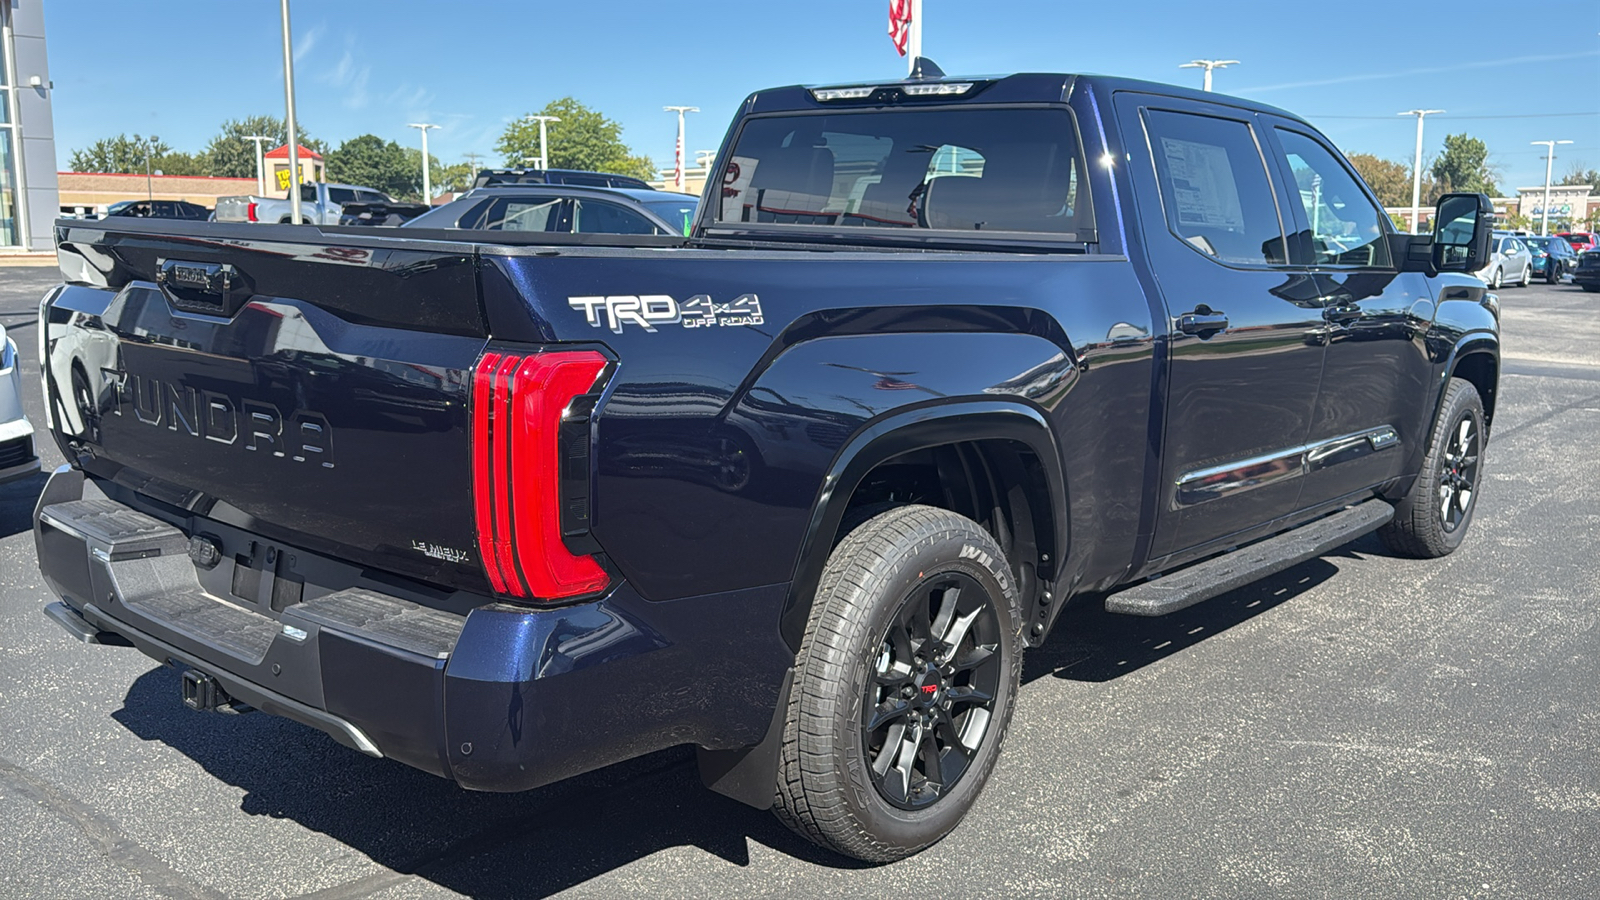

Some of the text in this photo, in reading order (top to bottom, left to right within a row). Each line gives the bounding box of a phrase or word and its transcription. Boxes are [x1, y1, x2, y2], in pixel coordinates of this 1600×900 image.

[567, 294, 682, 334] TRD
[682, 316, 765, 329] OFF ROAD
[99, 366, 335, 469] TUNDRA
[920, 684, 938, 694] TRD
